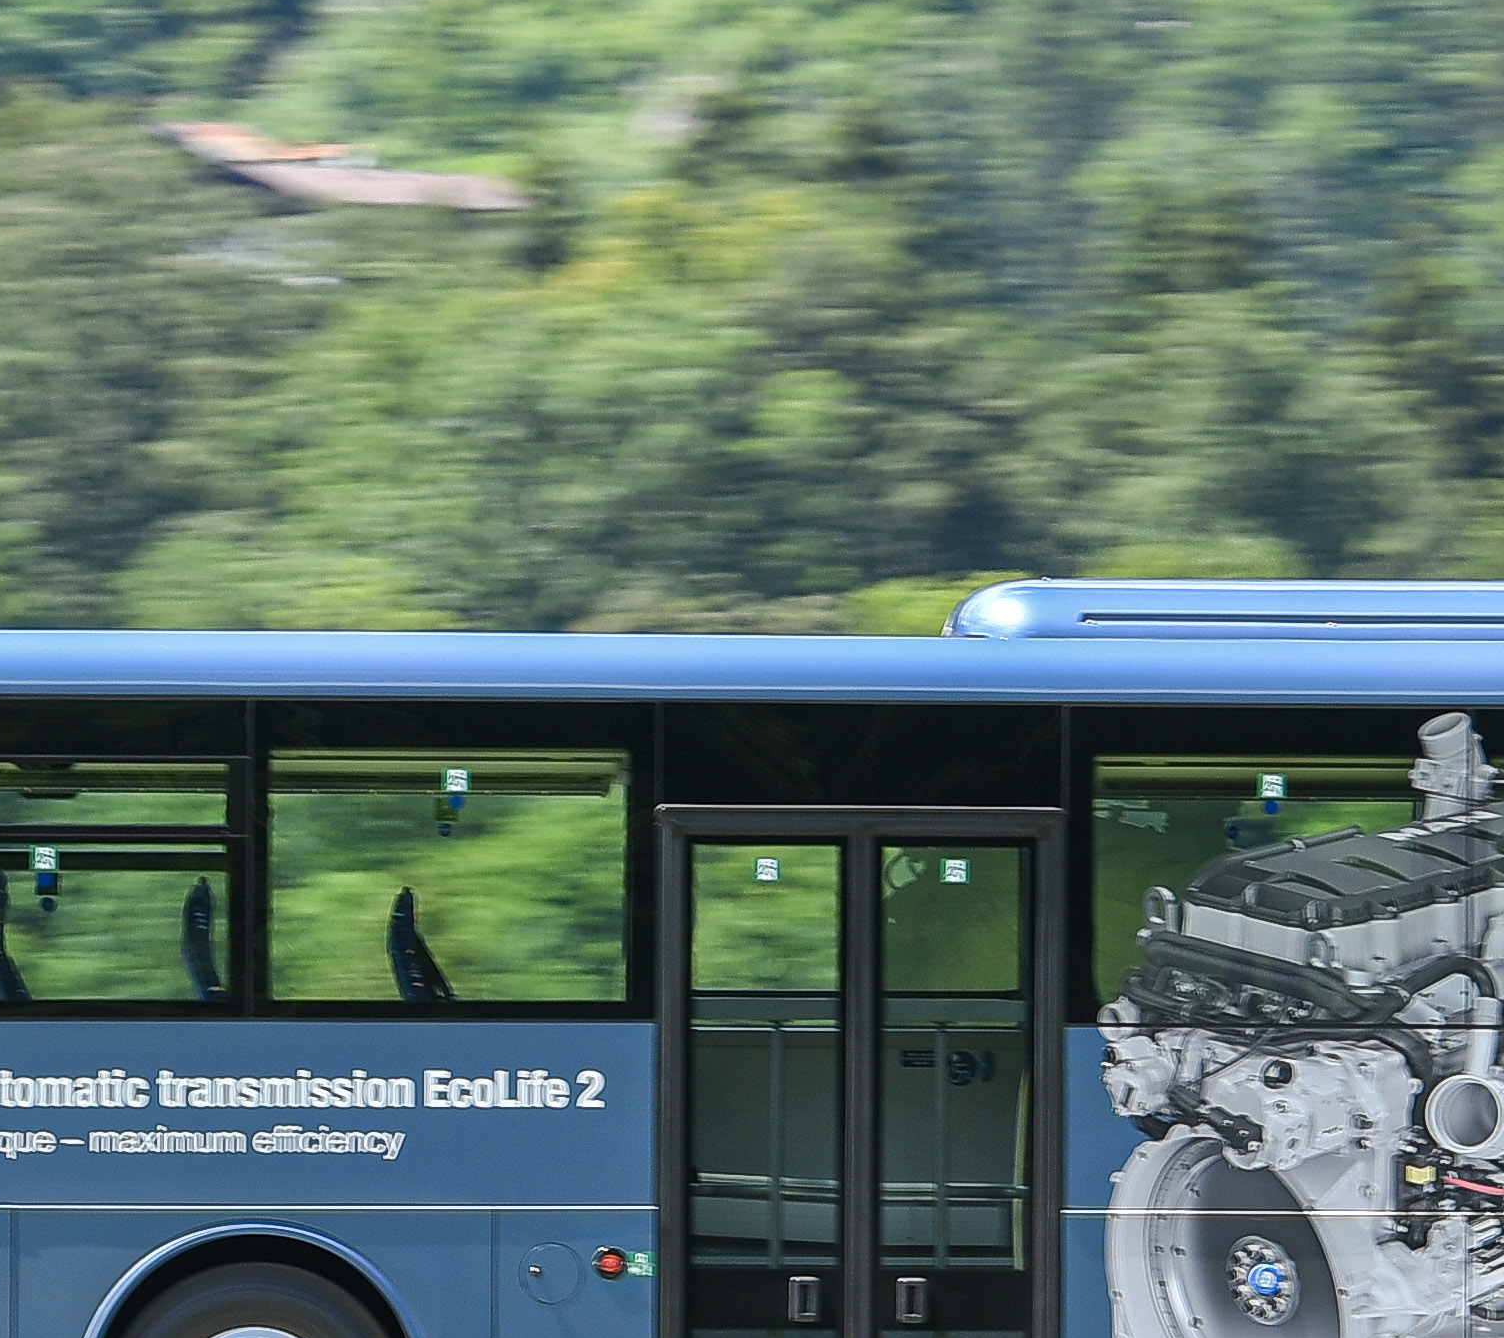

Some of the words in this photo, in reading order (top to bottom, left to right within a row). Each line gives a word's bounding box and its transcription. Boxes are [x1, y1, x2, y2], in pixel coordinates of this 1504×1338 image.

[155, 1069, 416, 1108] transmission
[423, 1069, 571, 1109] EcoLife
[575, 1070, 606, 1108] 2
[88, 1124, 247, 1154] maximum
[251, 1124, 406, 1160] efficiency
